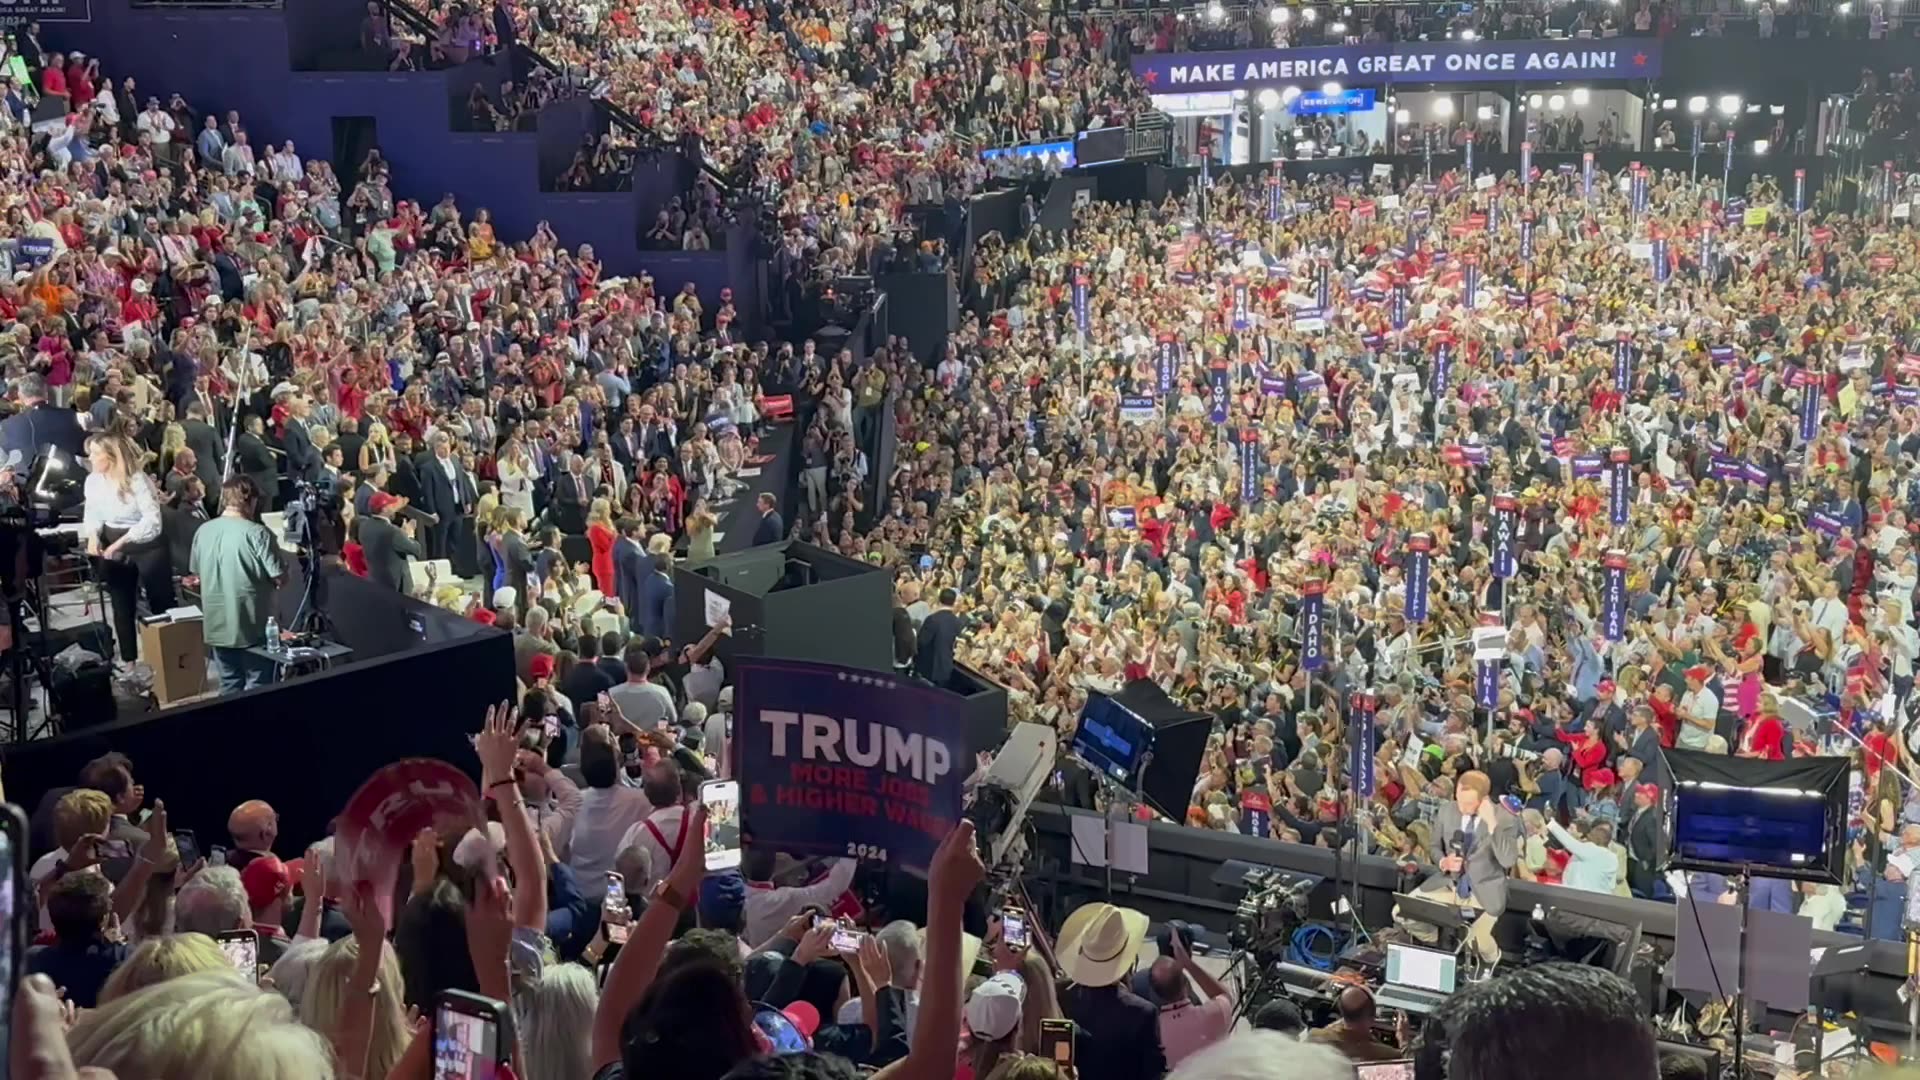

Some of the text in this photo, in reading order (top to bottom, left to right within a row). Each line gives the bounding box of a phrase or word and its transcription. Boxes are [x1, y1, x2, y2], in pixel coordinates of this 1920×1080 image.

[1170, 51, 1616, 84] MAKE AMERICA GREAT ONCE AGAIN!
[1236, 288, 1244, 321] GUAM
[1162, 343, 1170, 390] OREGON
[1437, 343, 1445, 391] INDIANA
[1214, 377, 1224, 412] IOWA
[1497, 510, 1510, 572] HAWAII
[1609, 569, 1620, 636] MICHIGAN
[1307, 602, 1318, 658] IDAHO
[1483, 660, 1491, 705] GINIA
[760, 709, 950, 785] TRUMP
[751, 783, 768, 804] &
[775, 785, 876, 816] HIGHER
[790, 763, 868, 792] MORE
[847, 842, 887, 861] 2024
